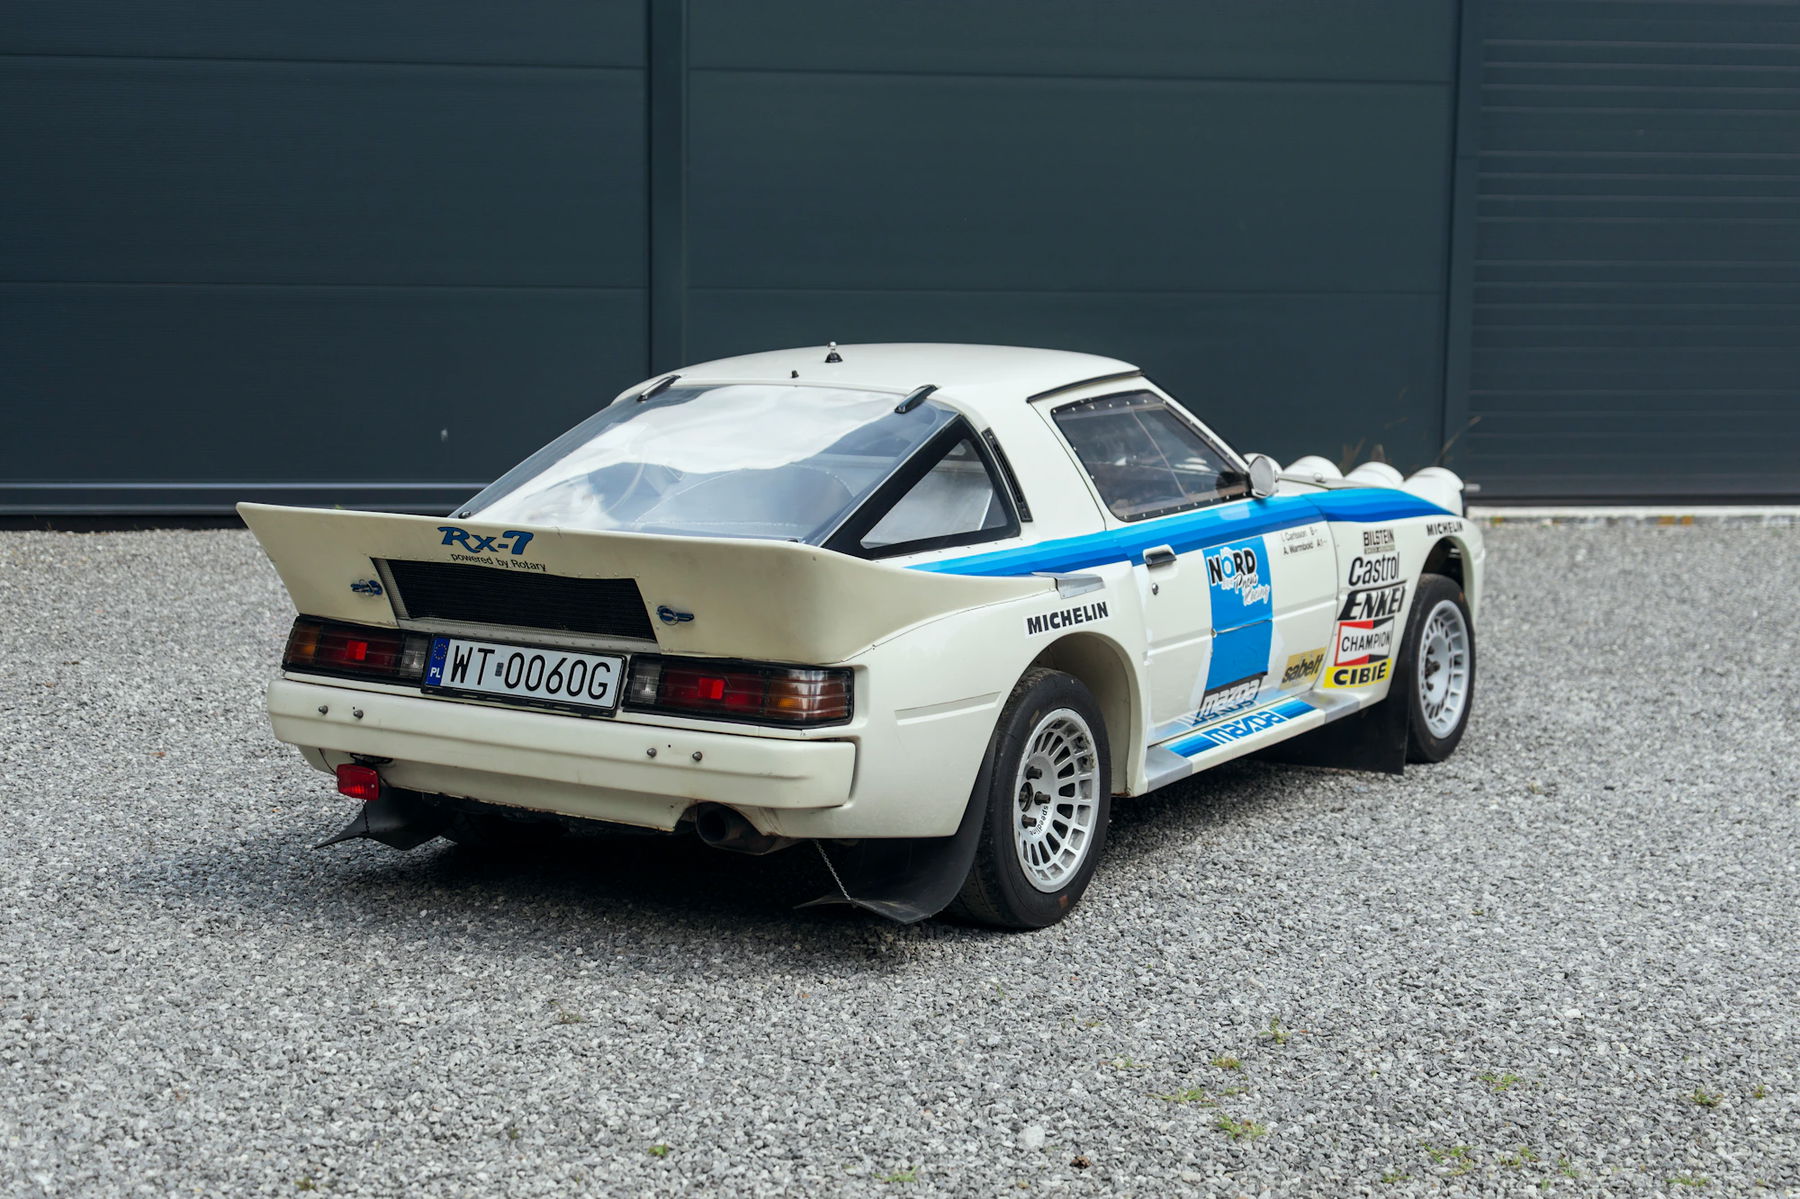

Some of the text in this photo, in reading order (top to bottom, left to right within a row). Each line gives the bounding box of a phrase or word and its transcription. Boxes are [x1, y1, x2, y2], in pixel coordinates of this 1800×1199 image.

[1363, 528, 1395, 546] BILSTEIN
[1426, 520, 1463, 536] MICHELIN
[451, 553, 547, 572] powered by Rotary
[1208, 549, 1256, 584] NORD
[1348, 551, 1400, 586] Castrol
[1338, 584, 1407, 620] ENKEI
[1027, 601, 1109, 635] MICHELIN
[1341, 631, 1391, 652] CHAMPION
[430, 667, 441, 678] PL
[450, 645, 496, 685] WT
[1281, 653, 1324, 684] sabelt
